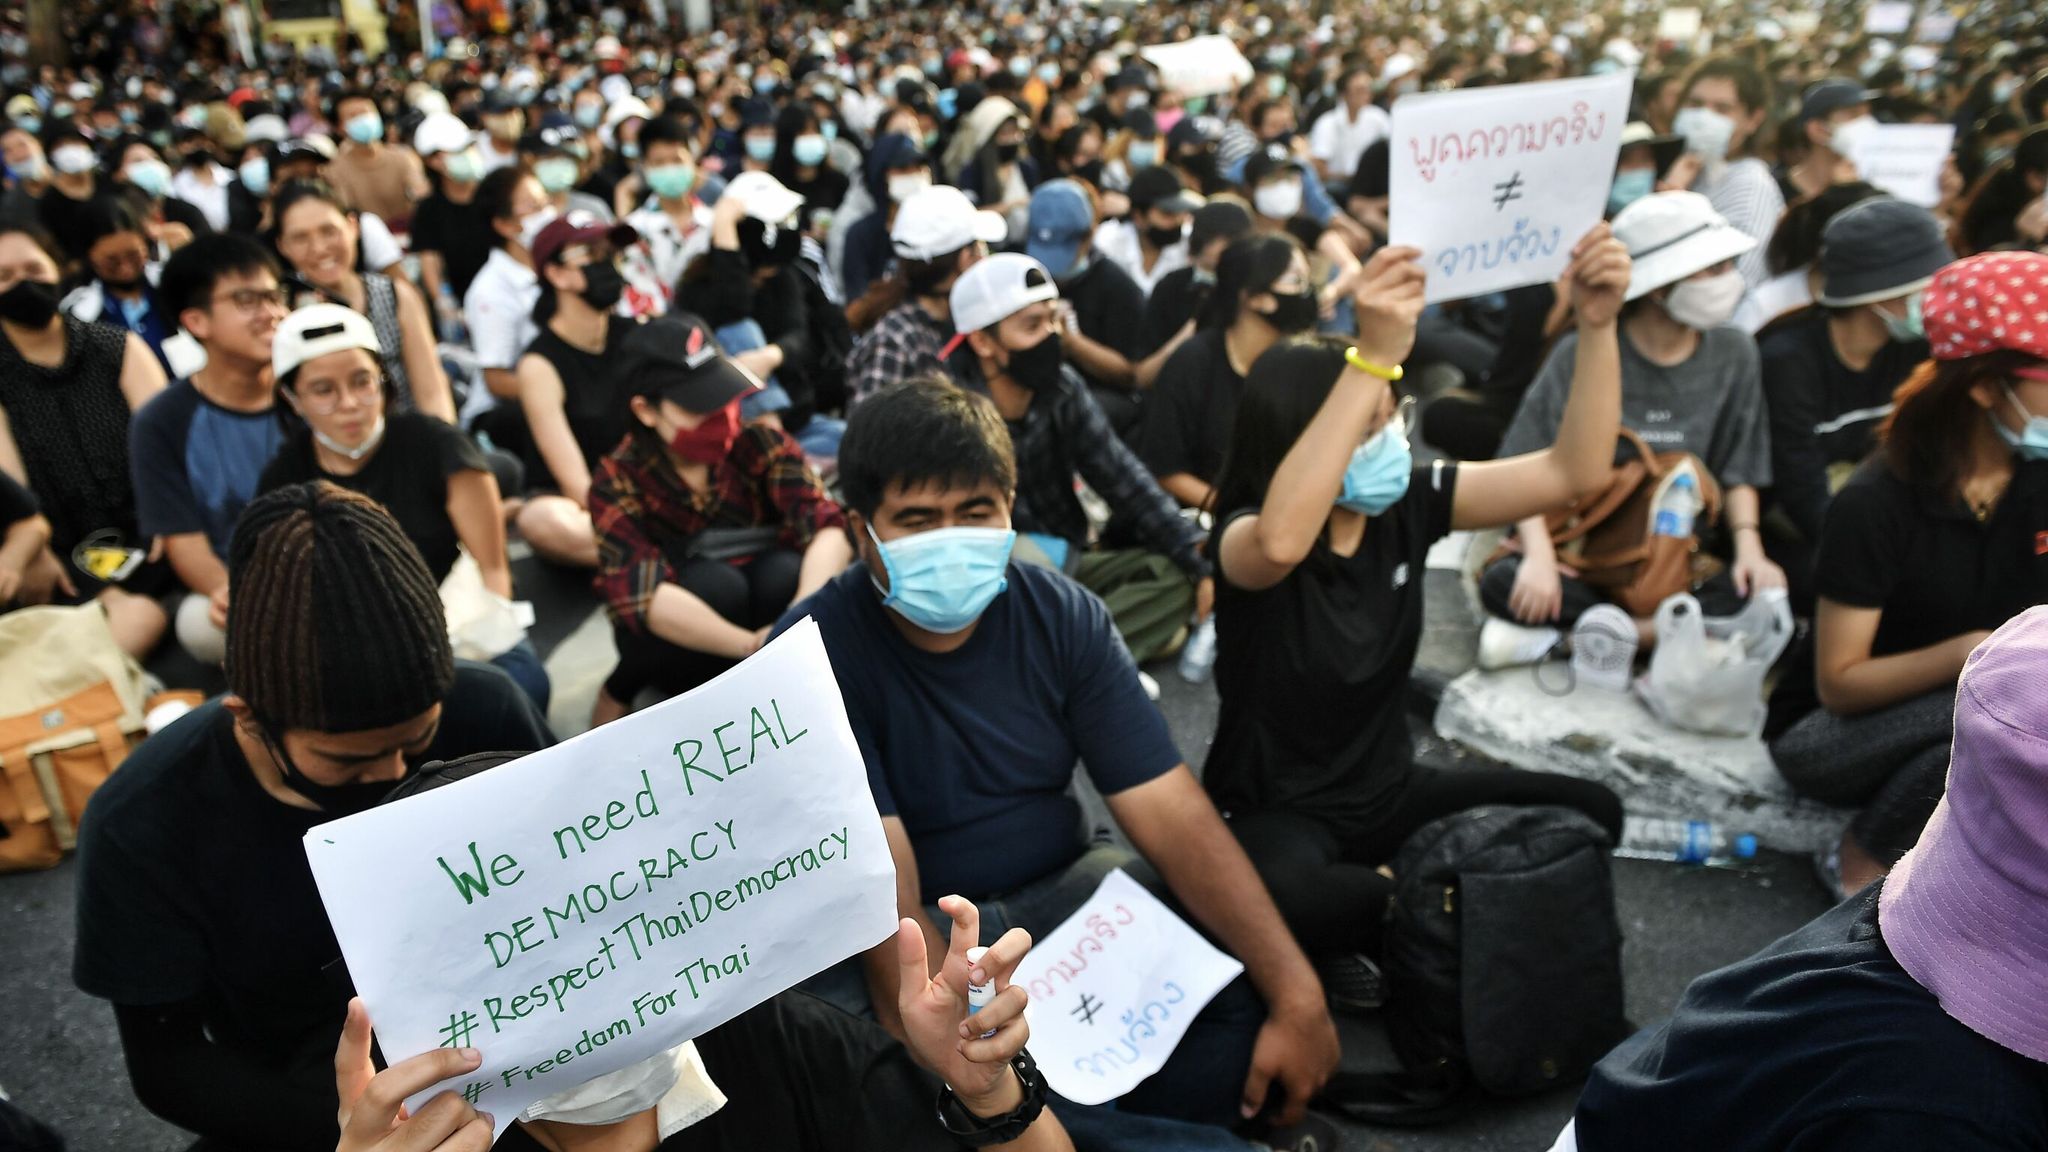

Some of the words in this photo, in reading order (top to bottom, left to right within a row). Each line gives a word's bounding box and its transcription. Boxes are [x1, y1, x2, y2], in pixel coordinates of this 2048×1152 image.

[1408, 101, 1606, 183] พูดความจริง
[1436, 217, 1560, 277] จาบจ้วง
[437, 841, 526, 906] We
[552, 768, 661, 862] need
[672, 698, 809, 797] REAL
[483, 819, 738, 969] DEMOCRACY
